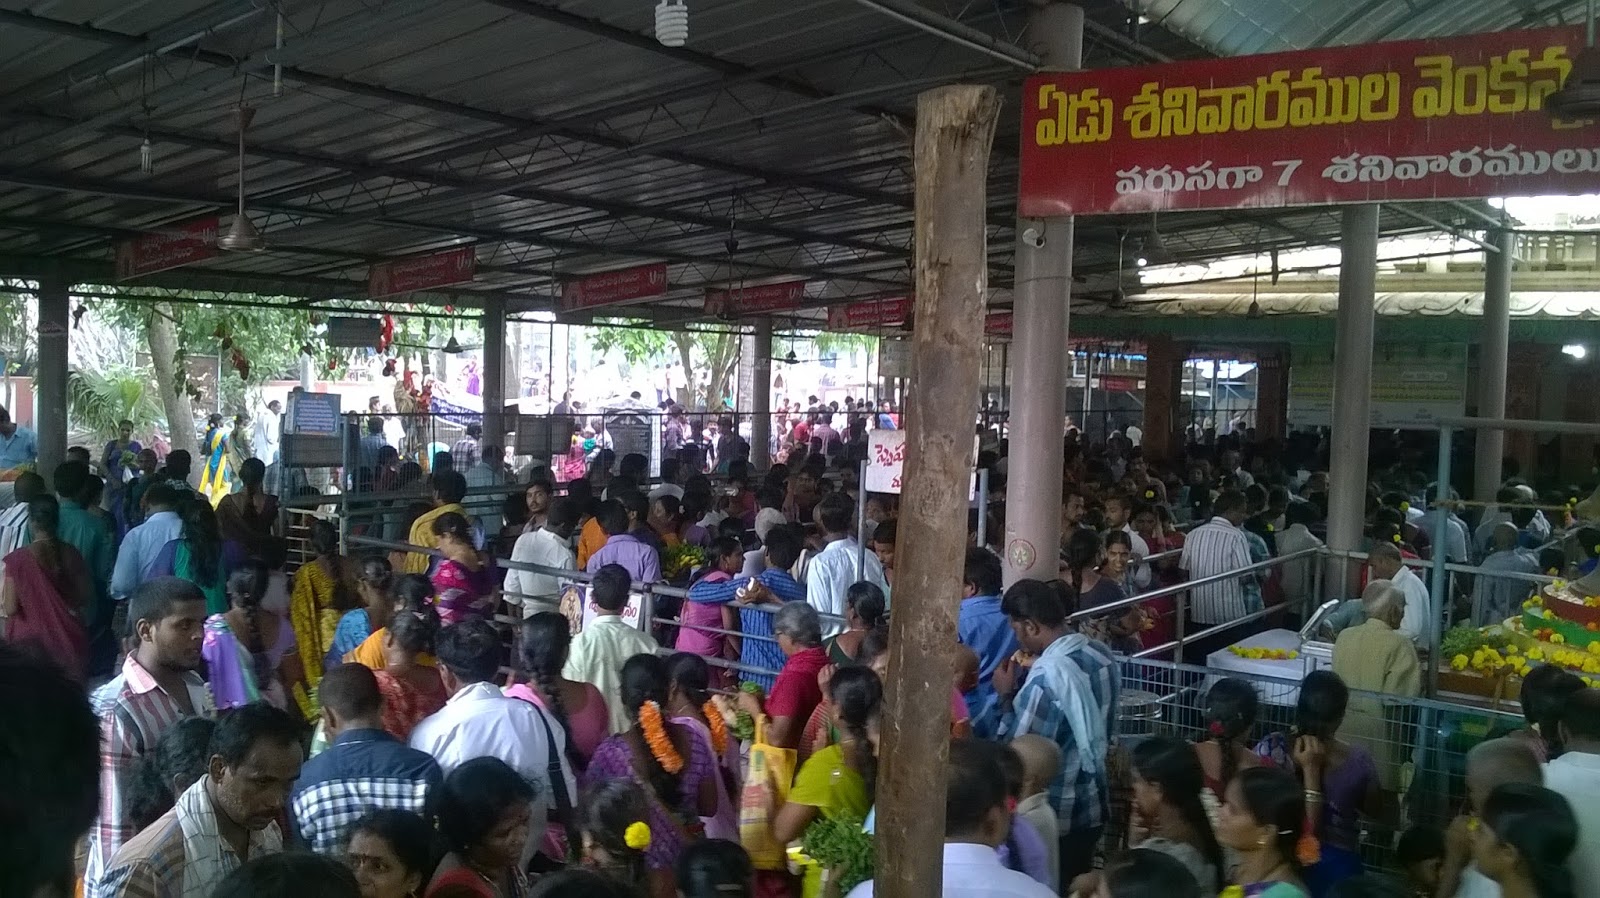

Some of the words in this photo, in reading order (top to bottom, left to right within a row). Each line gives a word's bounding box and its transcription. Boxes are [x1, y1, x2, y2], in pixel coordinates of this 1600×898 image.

[1037, 84, 1113, 146] ఏడు
[1123, 67, 1400, 139] శనివారముల
[1115, 161, 1263, 194] వరుసగా
[1272, 160, 1303, 187] 7
